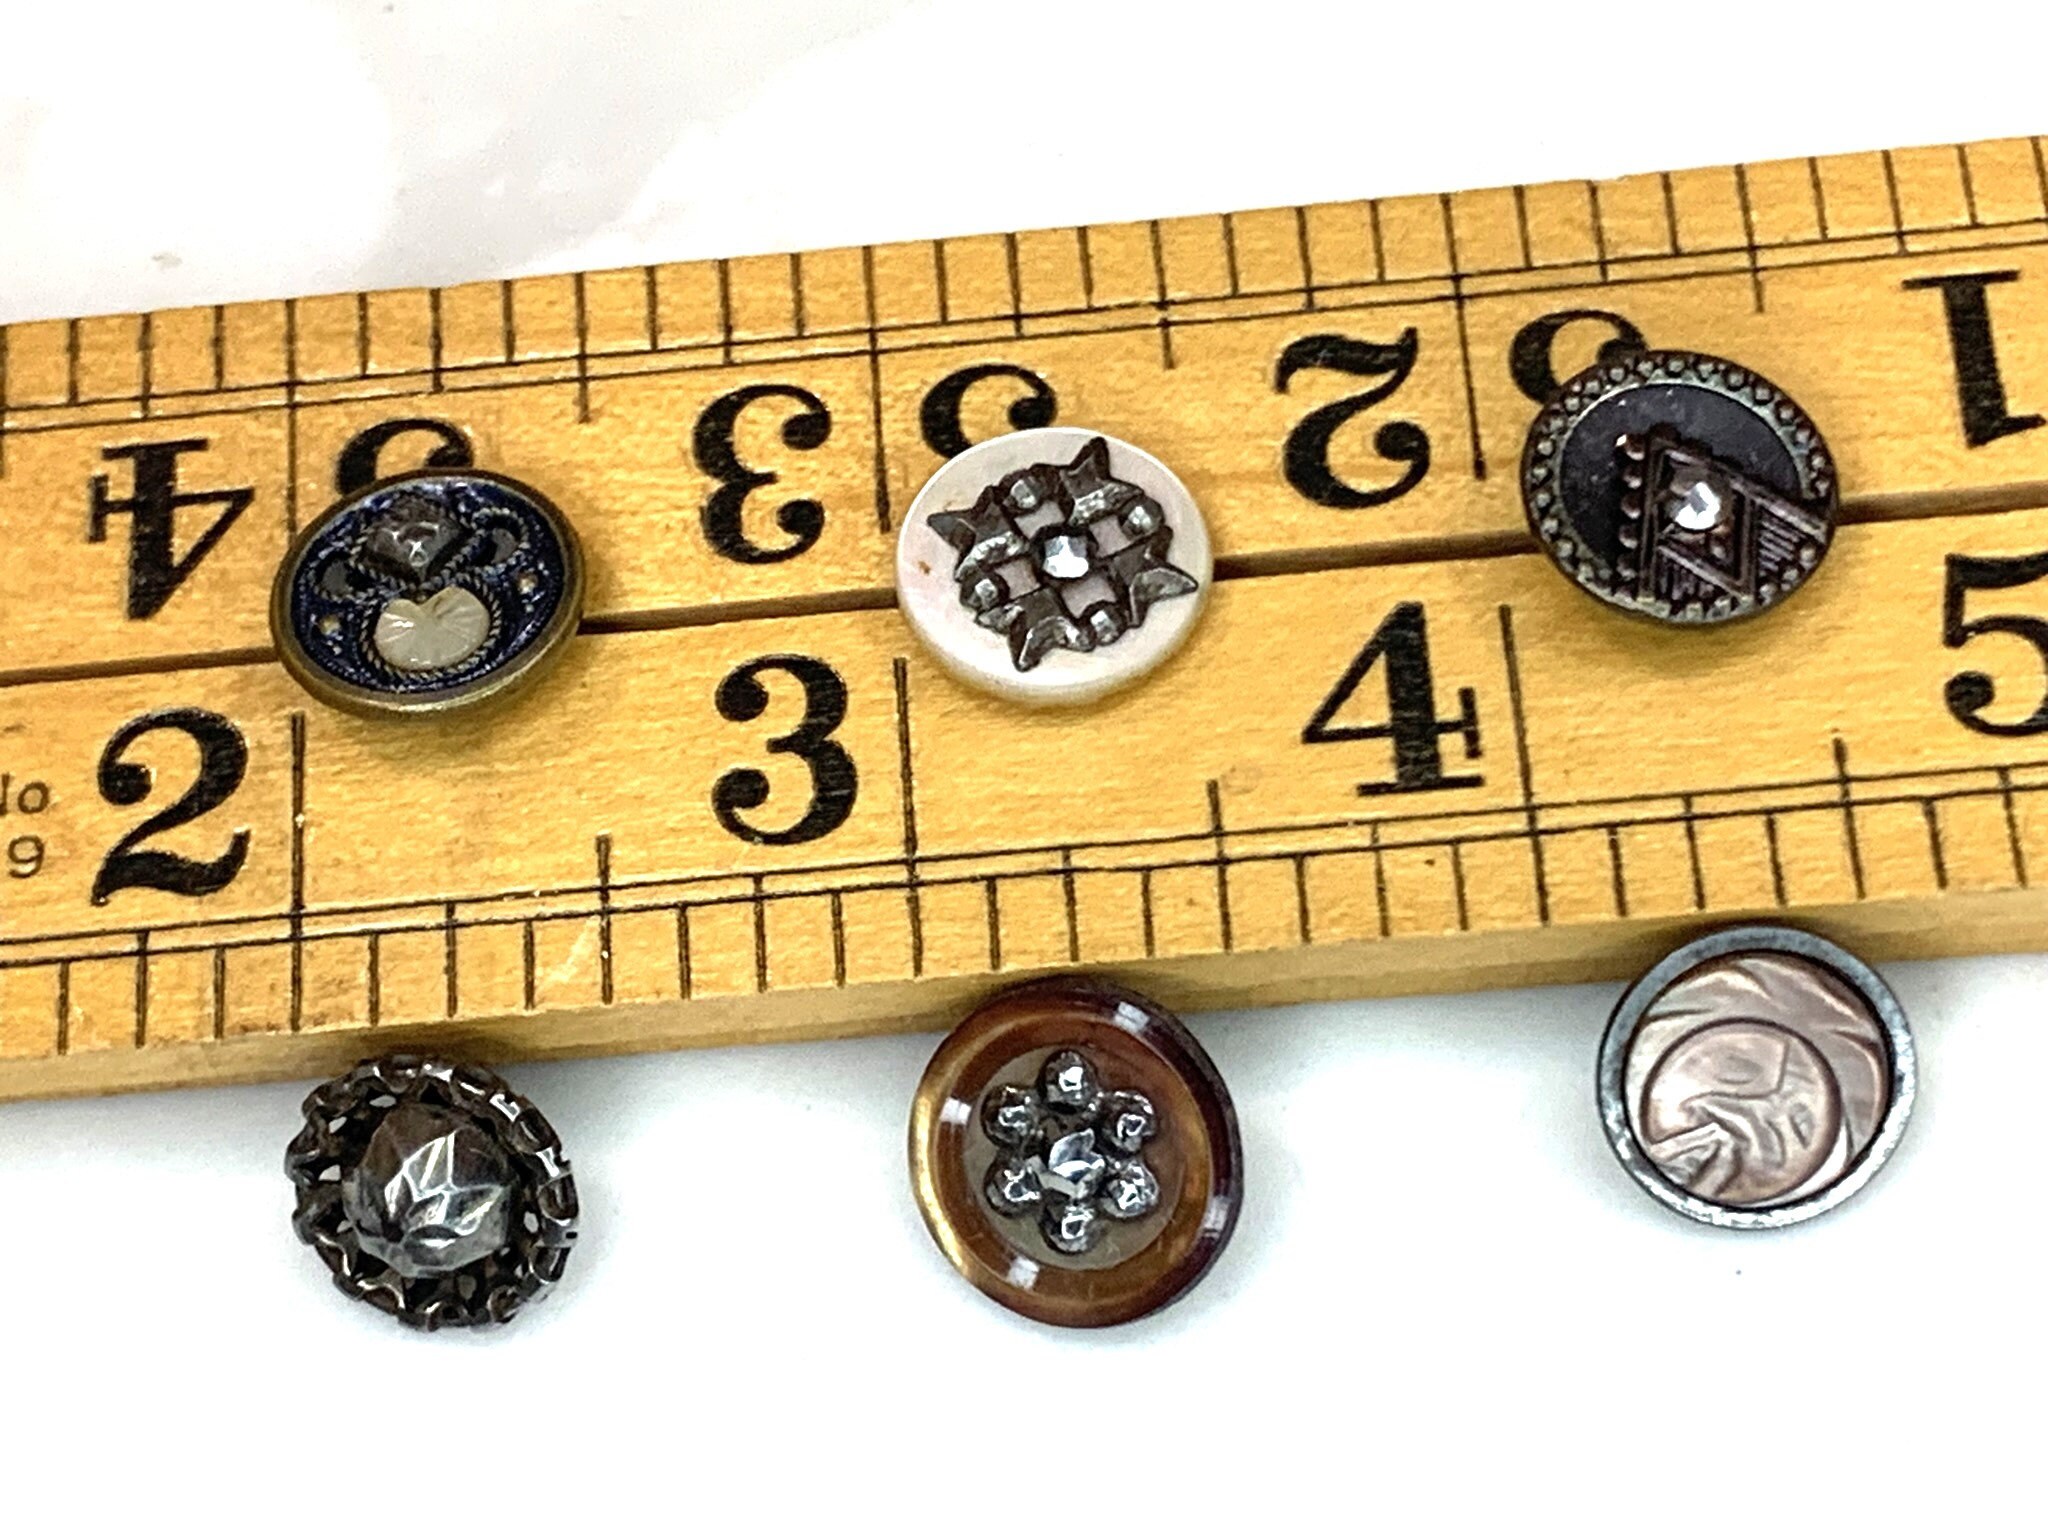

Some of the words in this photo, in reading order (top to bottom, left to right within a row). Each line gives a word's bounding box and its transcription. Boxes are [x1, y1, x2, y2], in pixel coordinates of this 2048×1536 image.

[1275, 326, 1431, 510] 2
[1902, 269, 2048, 448] 1
[87, 437, 256, 620] 4
[692, 383, 832, 566] 3
[1301, 602, 1485, 797] 4
[1942, 550, 2048, 738] 5
[90, 707, 251, 907] 2
[711, 654, 859, 846] 3
